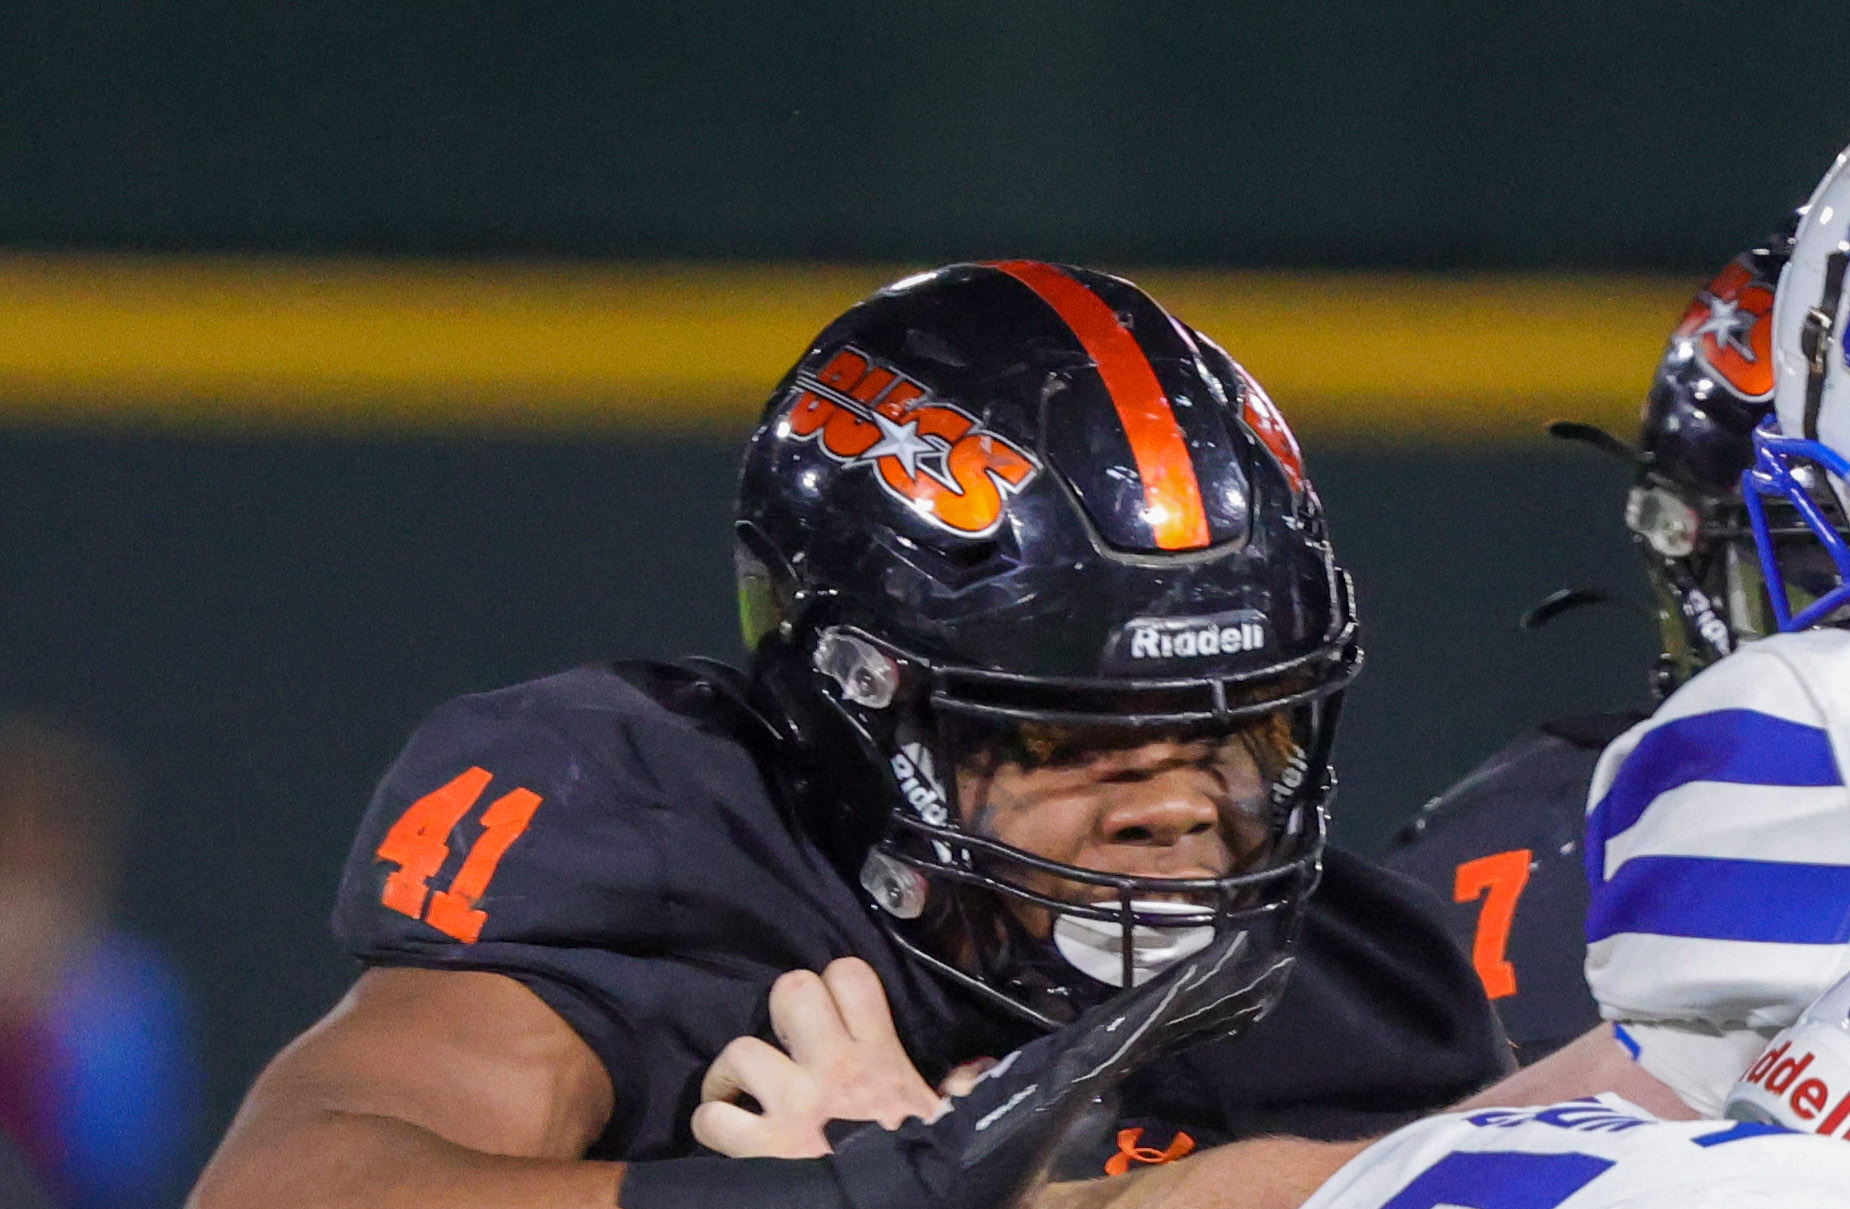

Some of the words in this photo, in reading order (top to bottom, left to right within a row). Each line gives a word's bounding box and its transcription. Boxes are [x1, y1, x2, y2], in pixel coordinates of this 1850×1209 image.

[1131, 623, 1265, 659] Riddell
[375, 765, 545, 944] 41
[1453, 848, 1535, 1000] 7
